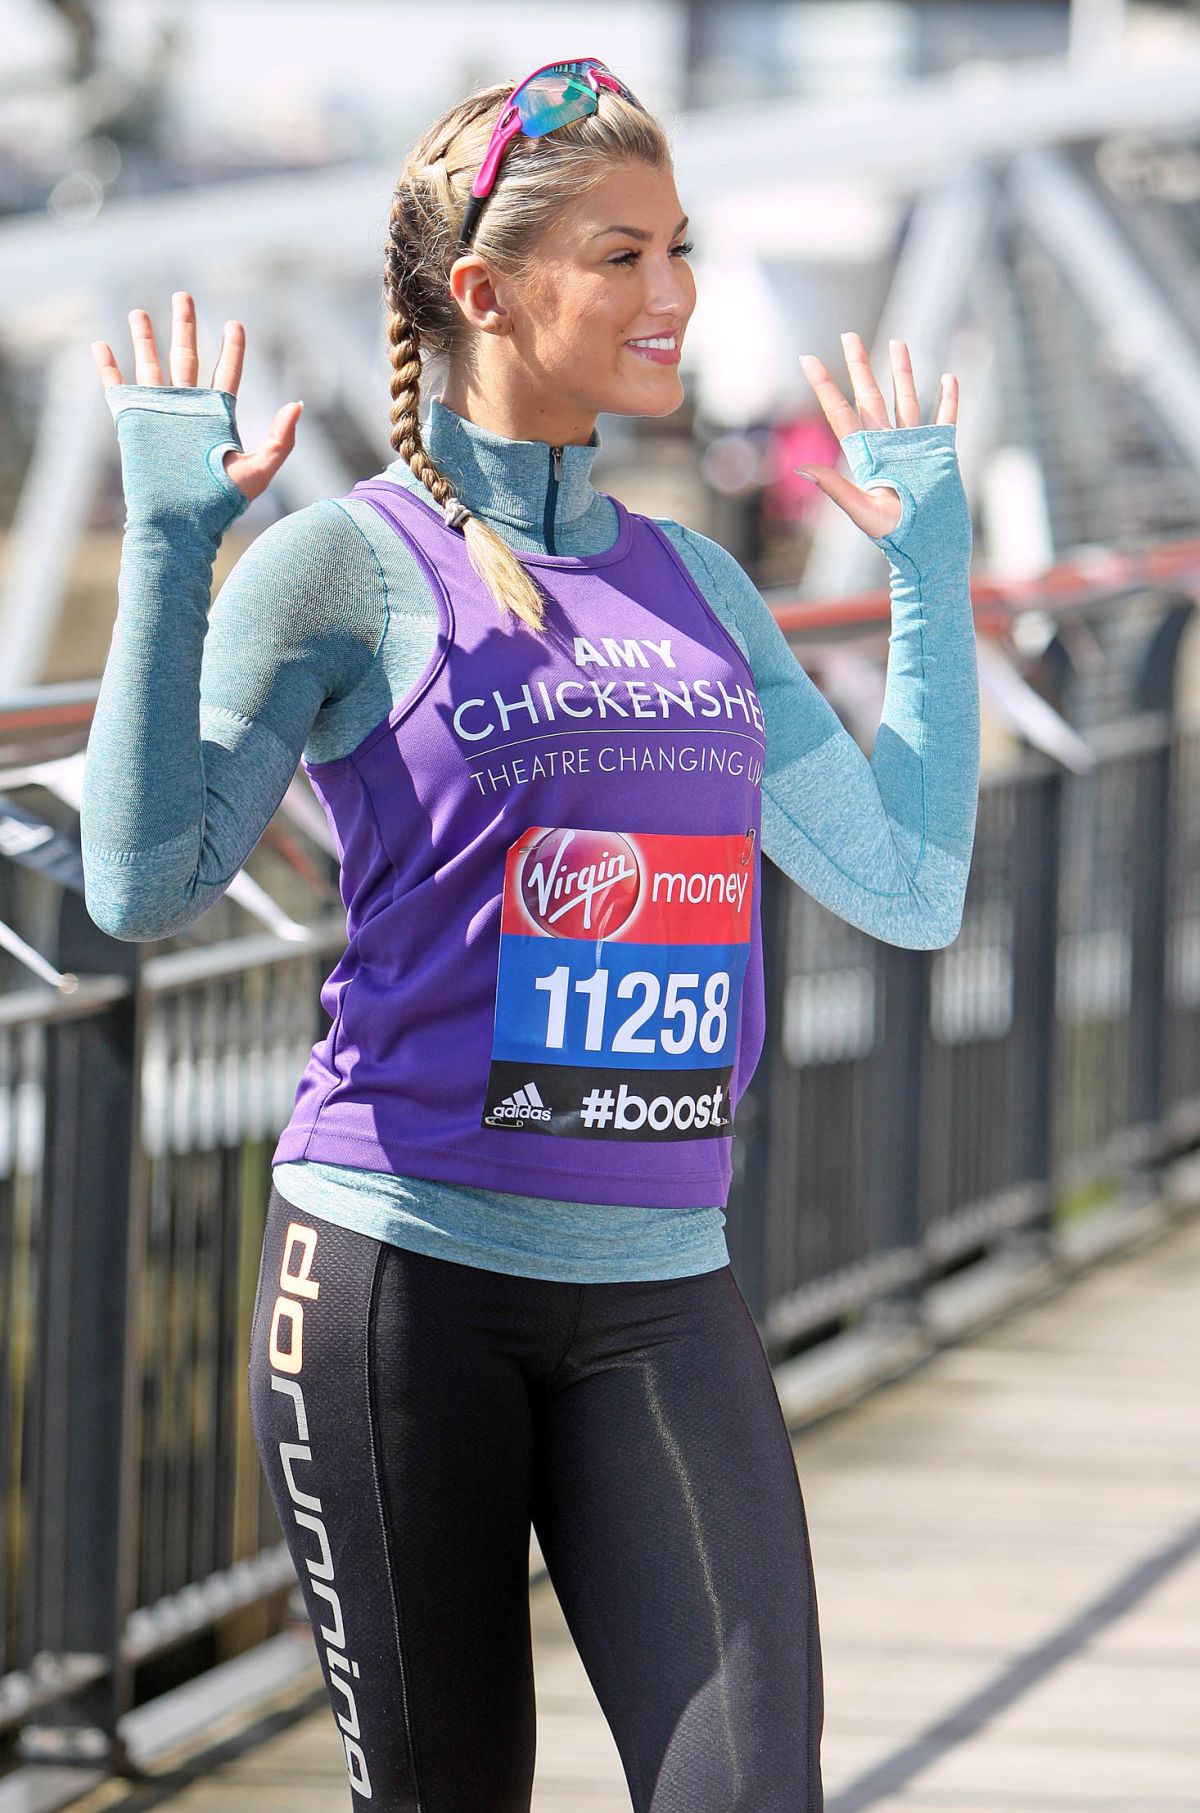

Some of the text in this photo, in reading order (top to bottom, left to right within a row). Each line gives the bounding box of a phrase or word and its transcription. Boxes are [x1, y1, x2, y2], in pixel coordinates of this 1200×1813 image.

[573, 637, 677, 668] AMY
[453, 679, 766, 741] CHICKENSHE
[470, 748, 591, 796] THEATRE
[598, 747, 744, 775] CHANGING
[528, 830, 748, 930] Virgin money
[535, 965, 730, 1054] 11258
[493, 1104, 552, 1122] adidas
[580, 1084, 724, 1131] #boost
